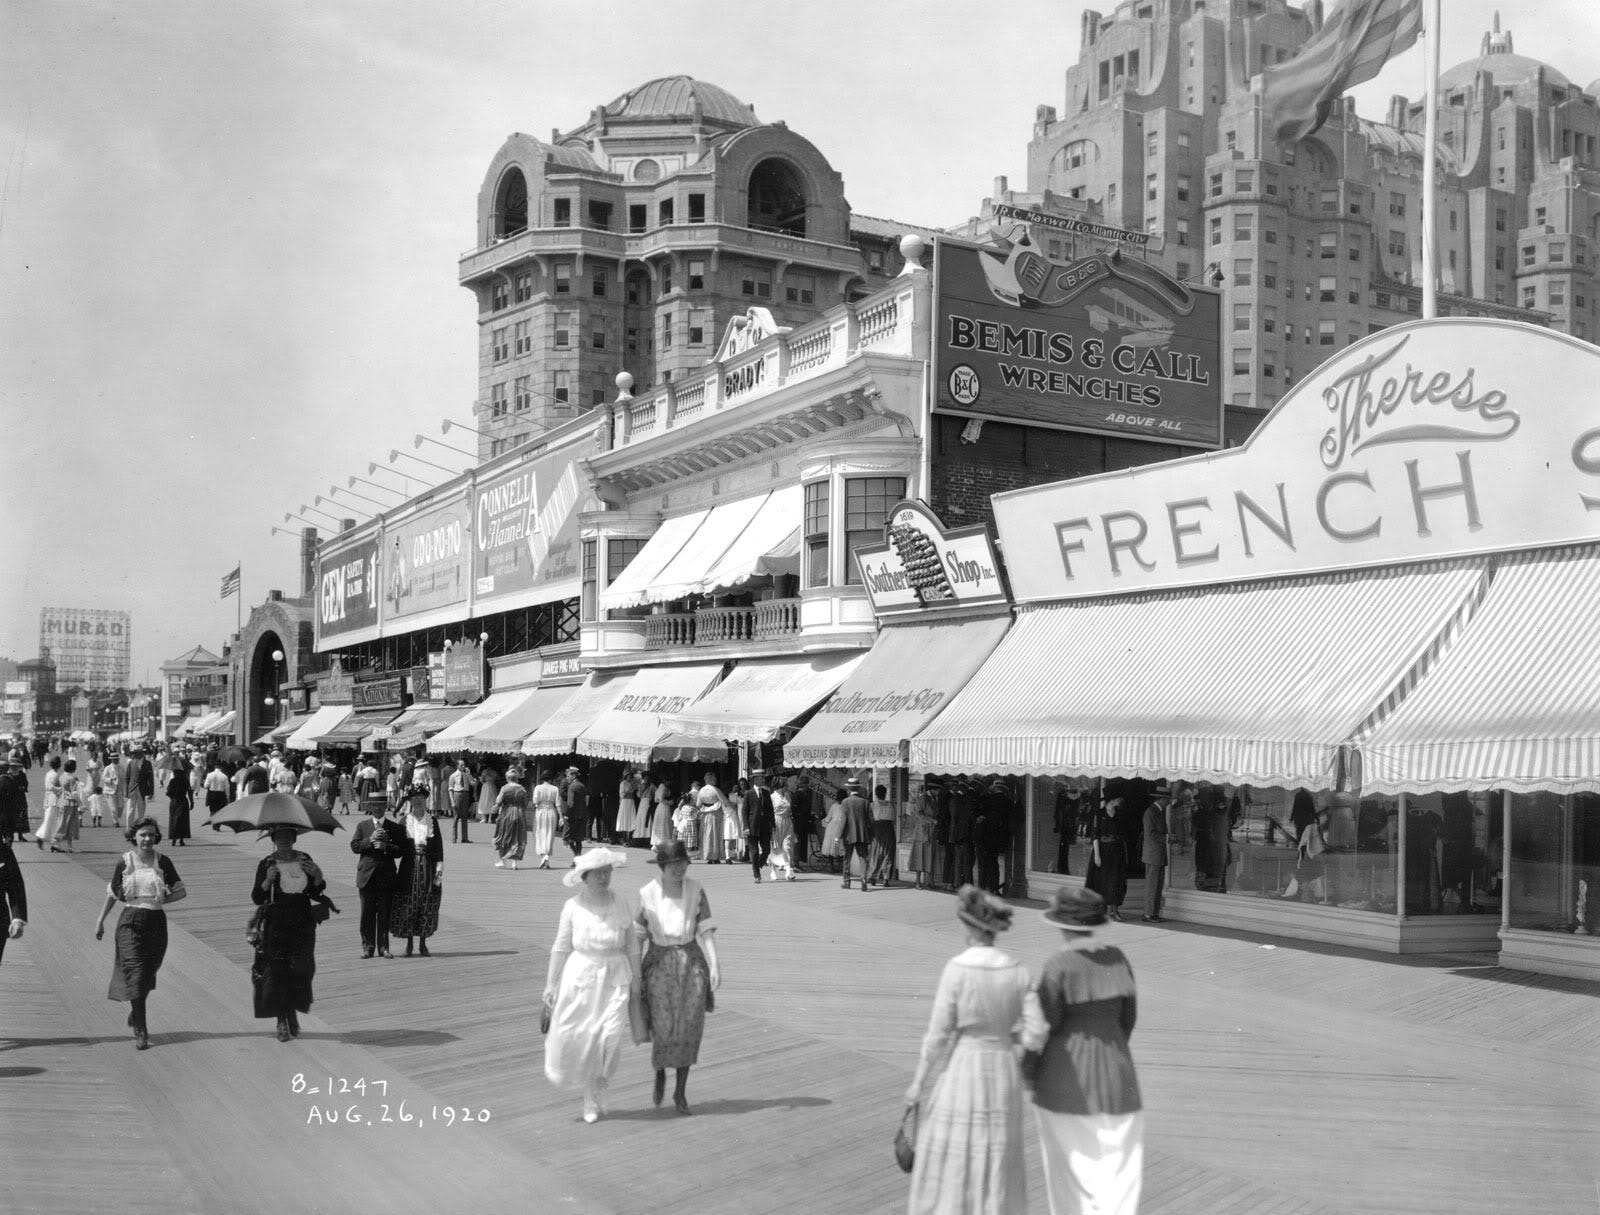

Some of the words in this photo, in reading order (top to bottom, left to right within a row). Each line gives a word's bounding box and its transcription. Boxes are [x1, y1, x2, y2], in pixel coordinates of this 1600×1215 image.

[1027, 212, 1074, 229] Maxwell
[1126, 232, 1147, 244] City
[949, 315, 1074, 364] BEMIS
[1081, 338, 1105, 369] &
[1111, 343, 1209, 386] CALL
[999, 362, 1161, 408] WRENCHES
[1319, 332, 1521, 470] Therese
[1105, 412, 1157, 428] ABOVE
[1158, 418, 1183, 431] ALL
[1053, 449, 1484, 582] FRENCH
[366, 550, 377, 609] $1
[945, 550, 981, 588] Shop
[321, 564, 346, 624] GEM
[47, 619, 123, 636] MURAD
[588, 741, 610, 752] SUITS
